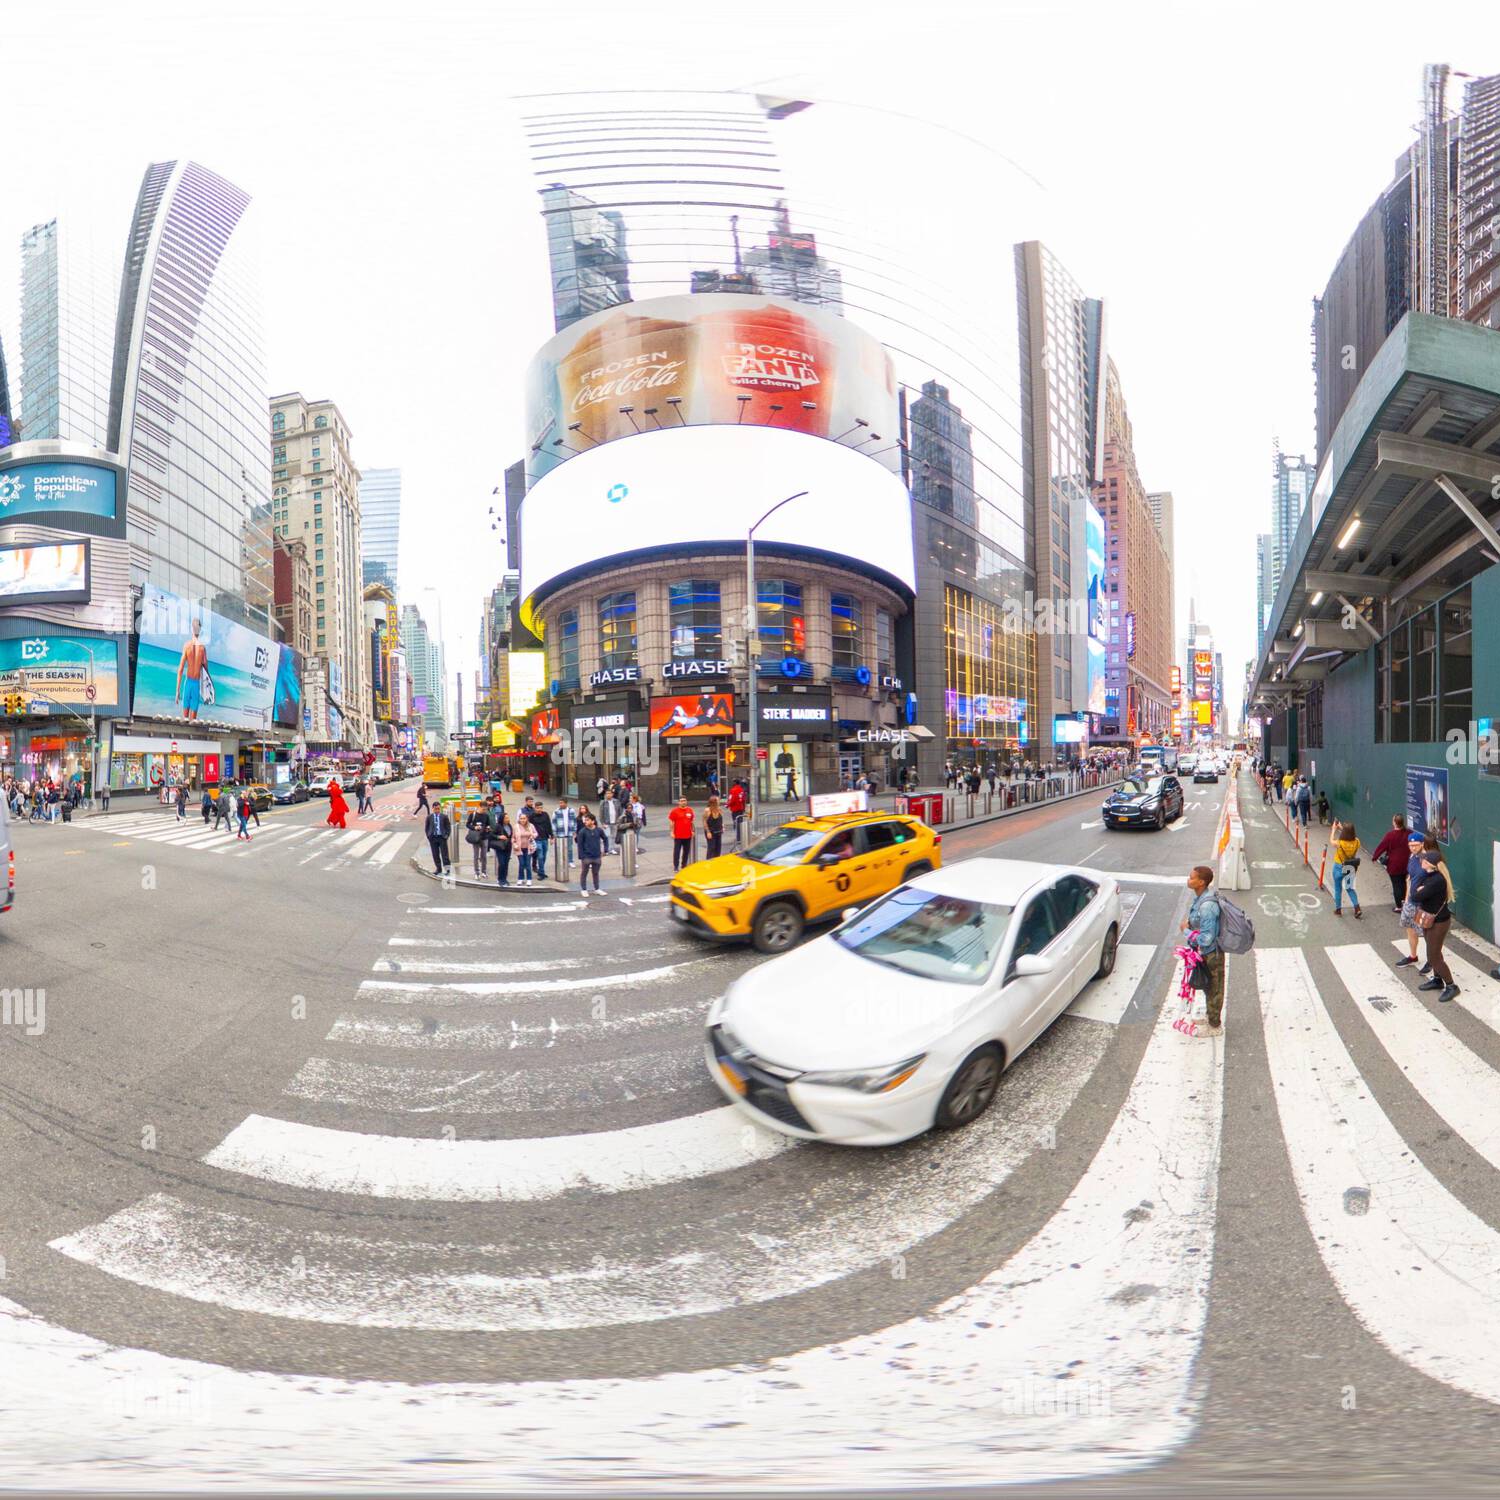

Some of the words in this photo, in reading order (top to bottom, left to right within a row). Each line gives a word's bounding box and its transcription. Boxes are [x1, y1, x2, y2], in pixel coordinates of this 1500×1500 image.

[725, 342, 816, 363] FROZEN
[580, 351, 668, 384] FROZEN
[725, 355, 820, 383] FANTA
[760, 377, 801, 391] cherry
[34, 475, 97, 487] Dominican
[34, 484, 87, 493] Republic
[589, 667, 639, 686] CHASE
[662, 660, 729, 678] CHASE
[857, 729, 910, 742] CHASE
